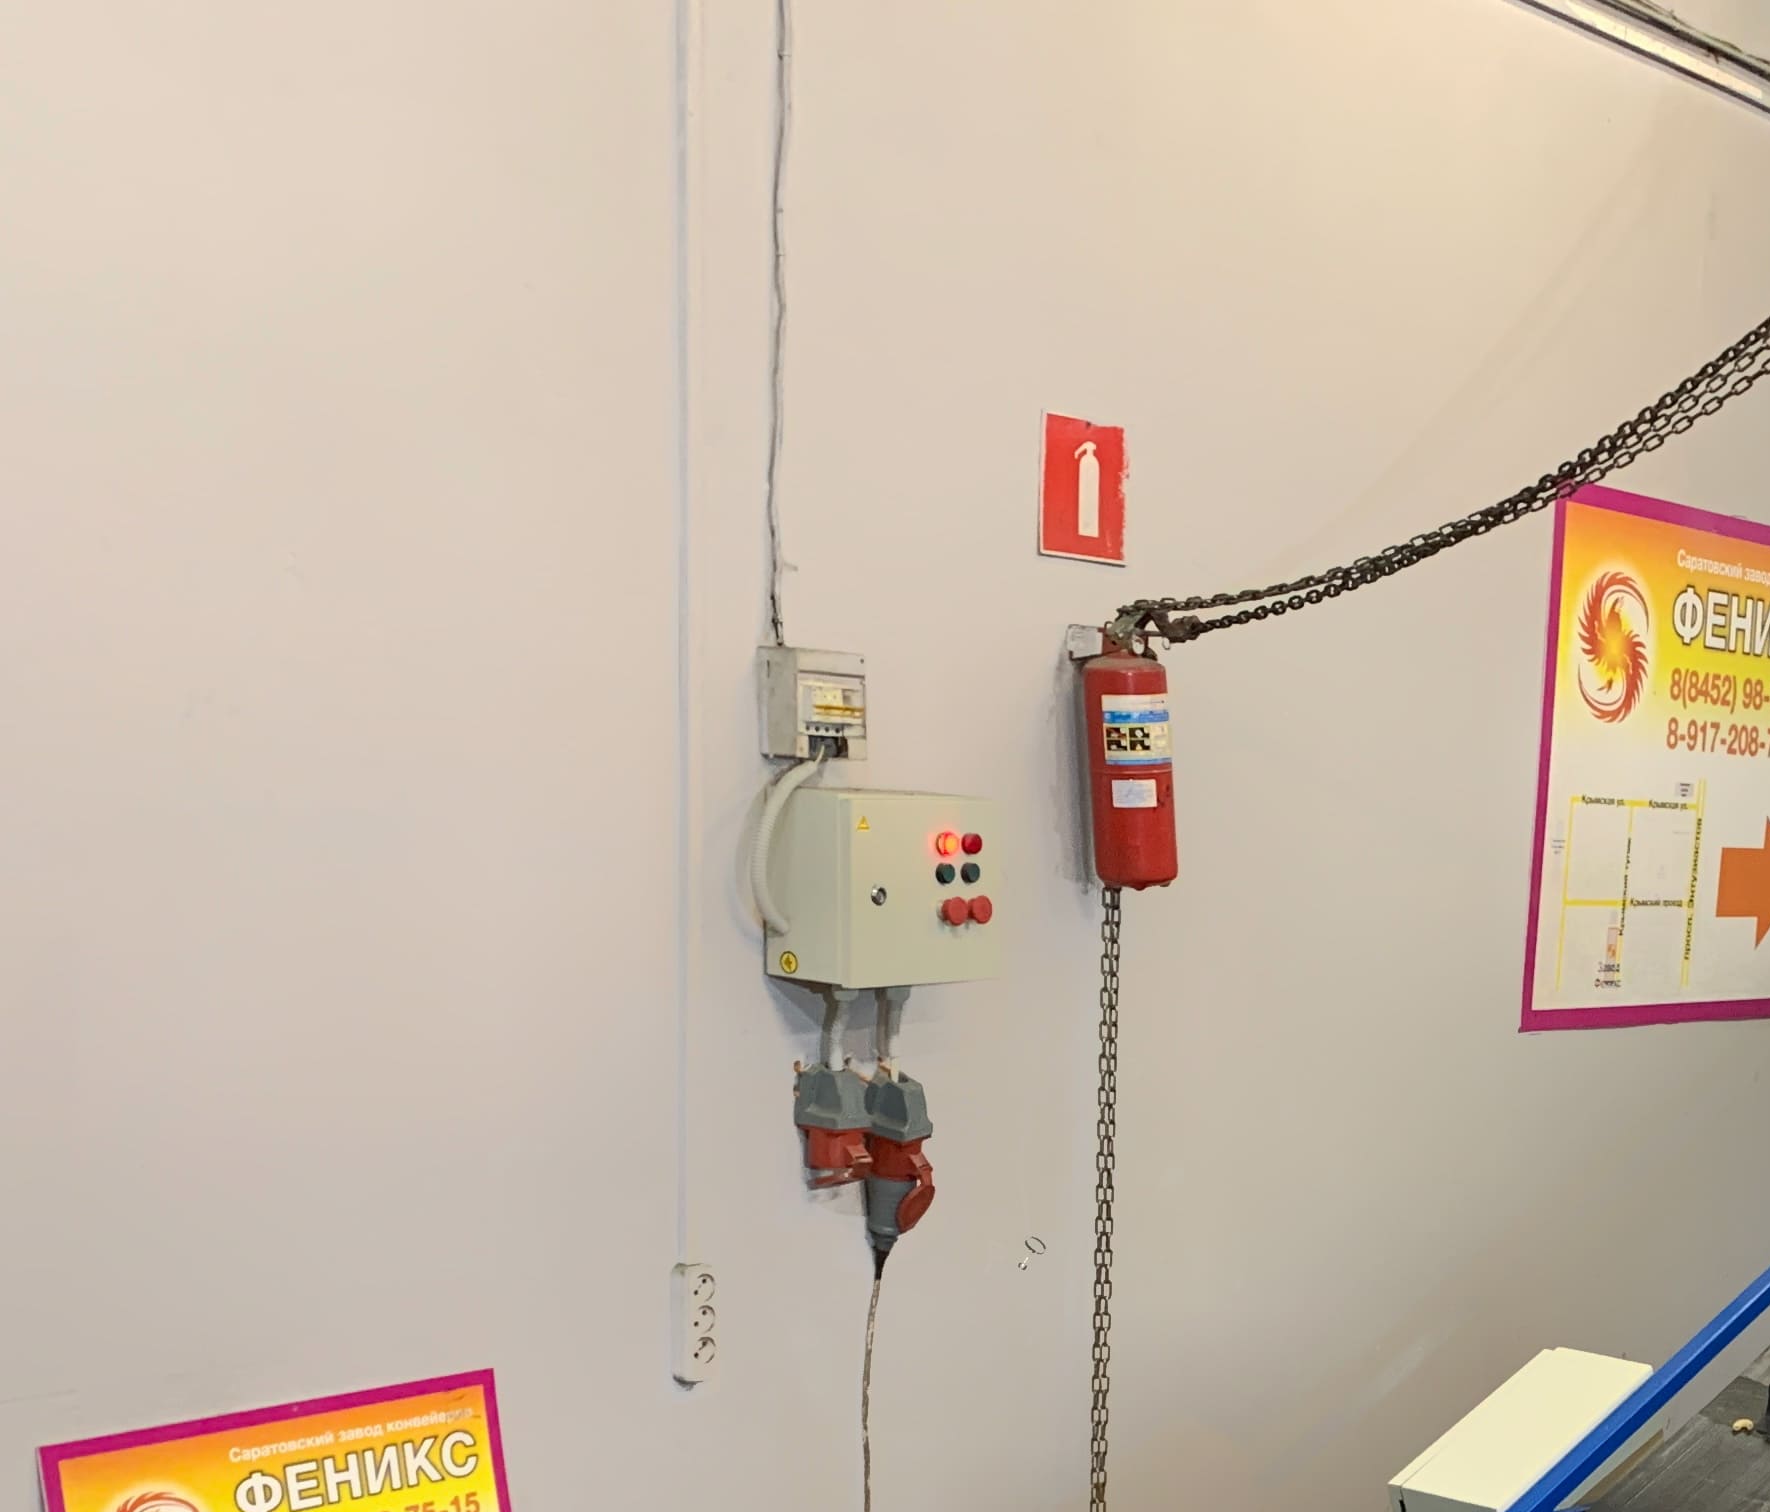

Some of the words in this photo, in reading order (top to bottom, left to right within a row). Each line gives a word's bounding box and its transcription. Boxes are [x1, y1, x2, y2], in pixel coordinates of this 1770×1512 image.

[1677, 549, 1742, 579] Саратовский
[1670, 668, 1737, 715] 8(8452)
[229, 1432, 335, 1463] Саратовский
[338, 1425, 384, 1445] завод
